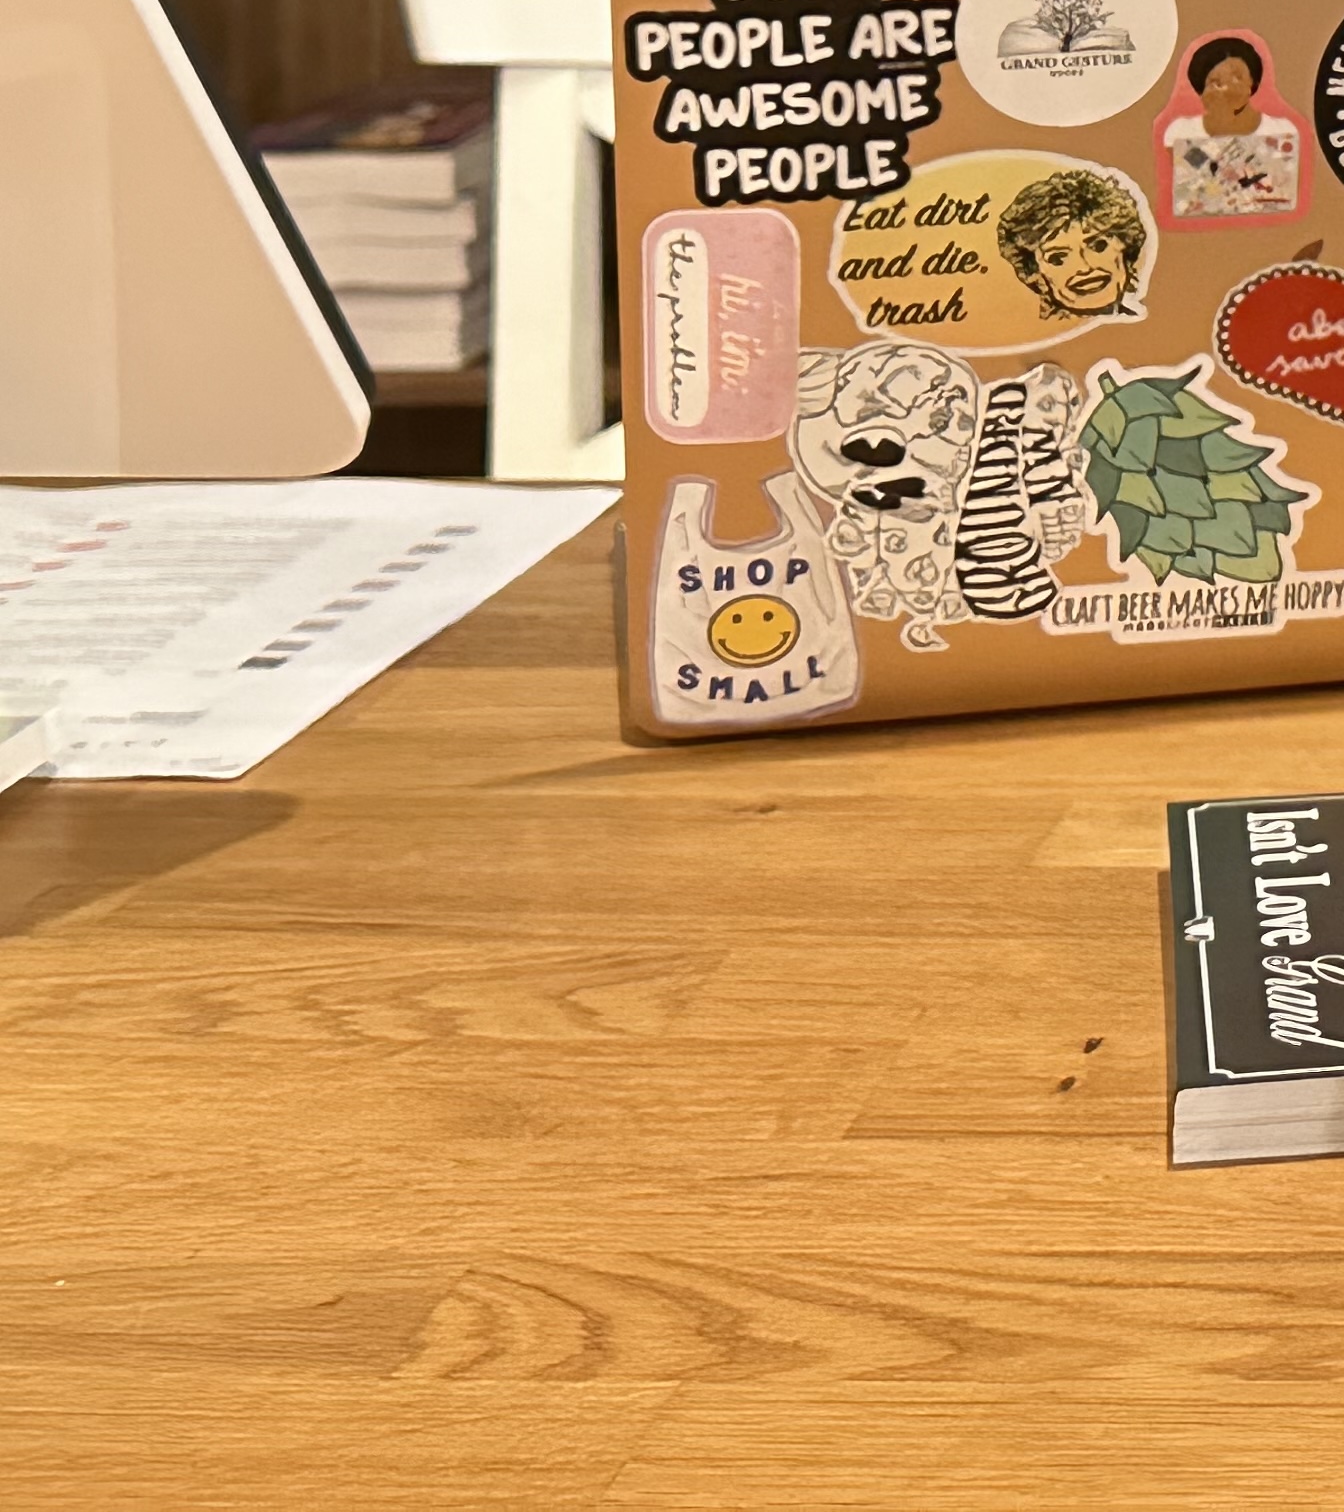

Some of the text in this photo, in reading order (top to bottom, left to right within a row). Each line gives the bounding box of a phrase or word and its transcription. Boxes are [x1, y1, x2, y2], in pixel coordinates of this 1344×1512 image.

[635, 9, 953, 72] PEOPLE ARE
[1000, 52, 1133, 71] GRAND GESTURE
[665, 74, 930, 133] AWESOME
[705, 139, 898, 197] PEOPLE
[843, 192, 990, 231] Eat dirt
[838, 240, 988, 281] and die.
[657, 233, 696, 421] the problem
[867, 287, 968, 327] trash
[678, 559, 809, 592] SHOP
[1052, 595, 1113, 626] CRAFT
[1118, 592, 1162, 622] BEER
[1168, 585, 1240, 619] MAKES
[1246, 583, 1278, 614] ME
[677, 656, 826, 703] SMALL
[1247, 808, 1328, 866] Isn't
[1255, 872, 1330, 947] Love
